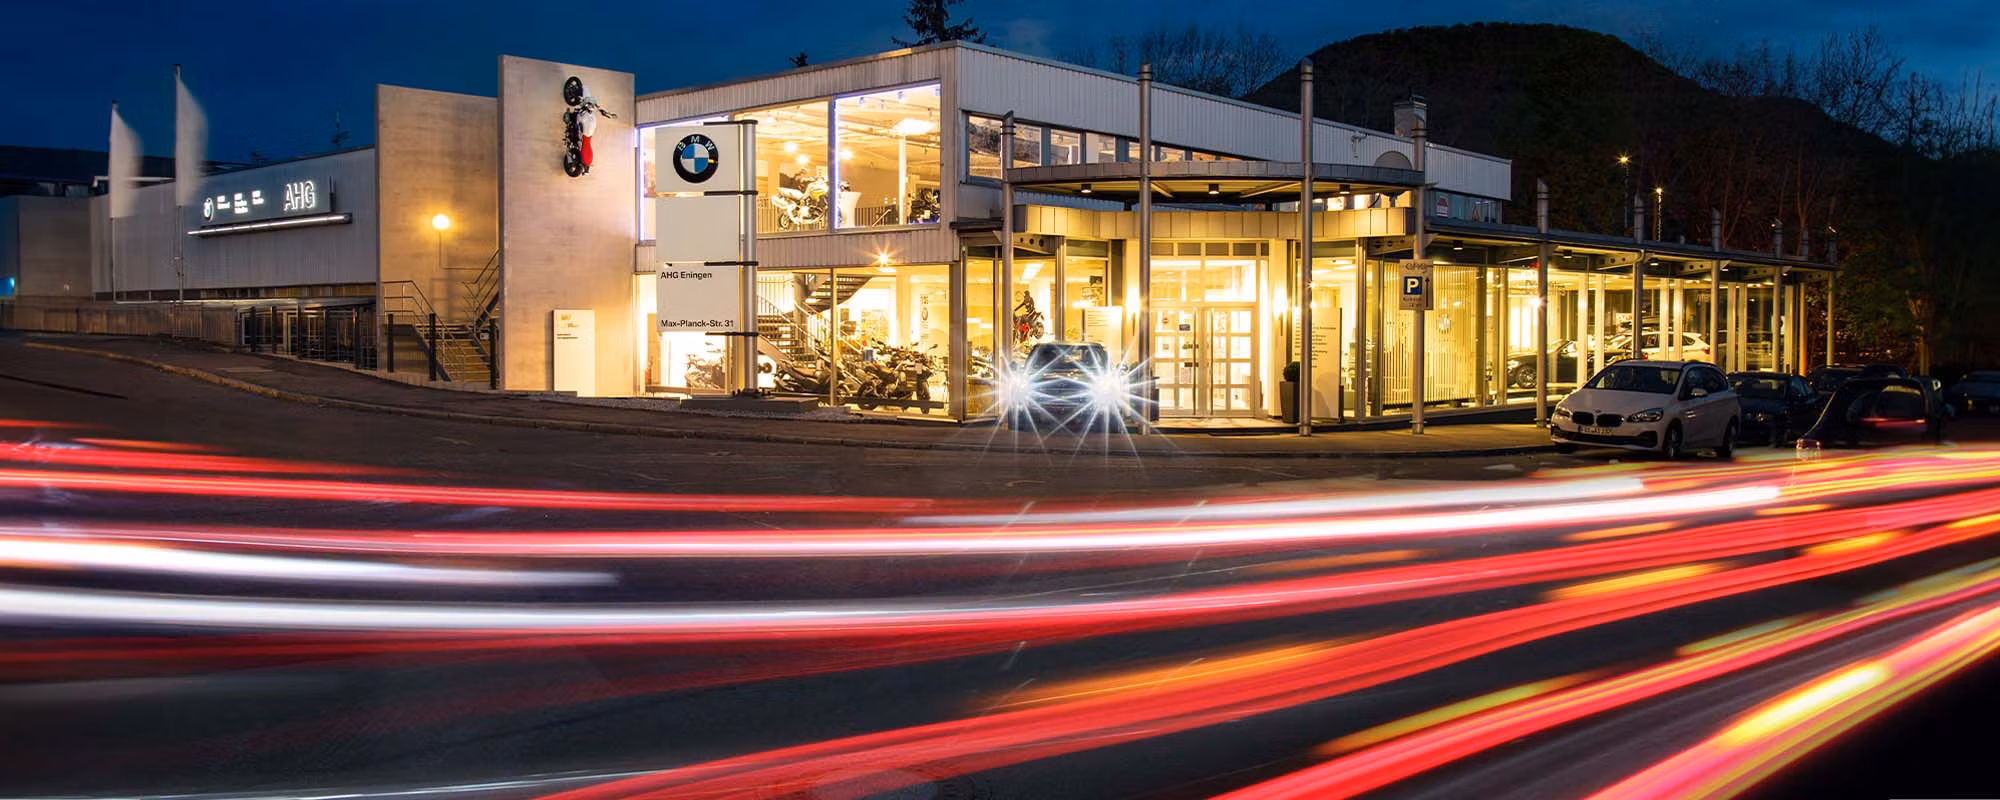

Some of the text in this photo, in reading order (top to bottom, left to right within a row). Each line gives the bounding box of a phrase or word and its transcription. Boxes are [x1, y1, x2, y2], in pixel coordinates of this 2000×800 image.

[677, 135, 715, 151] BMW
[283, 180, 316, 211] AHG
[660, 271, 712, 281] AHG Eningen
[1407, 278, 1419, 293] P
[661, 319, 734, 328] Max-Planck-Str. 31
